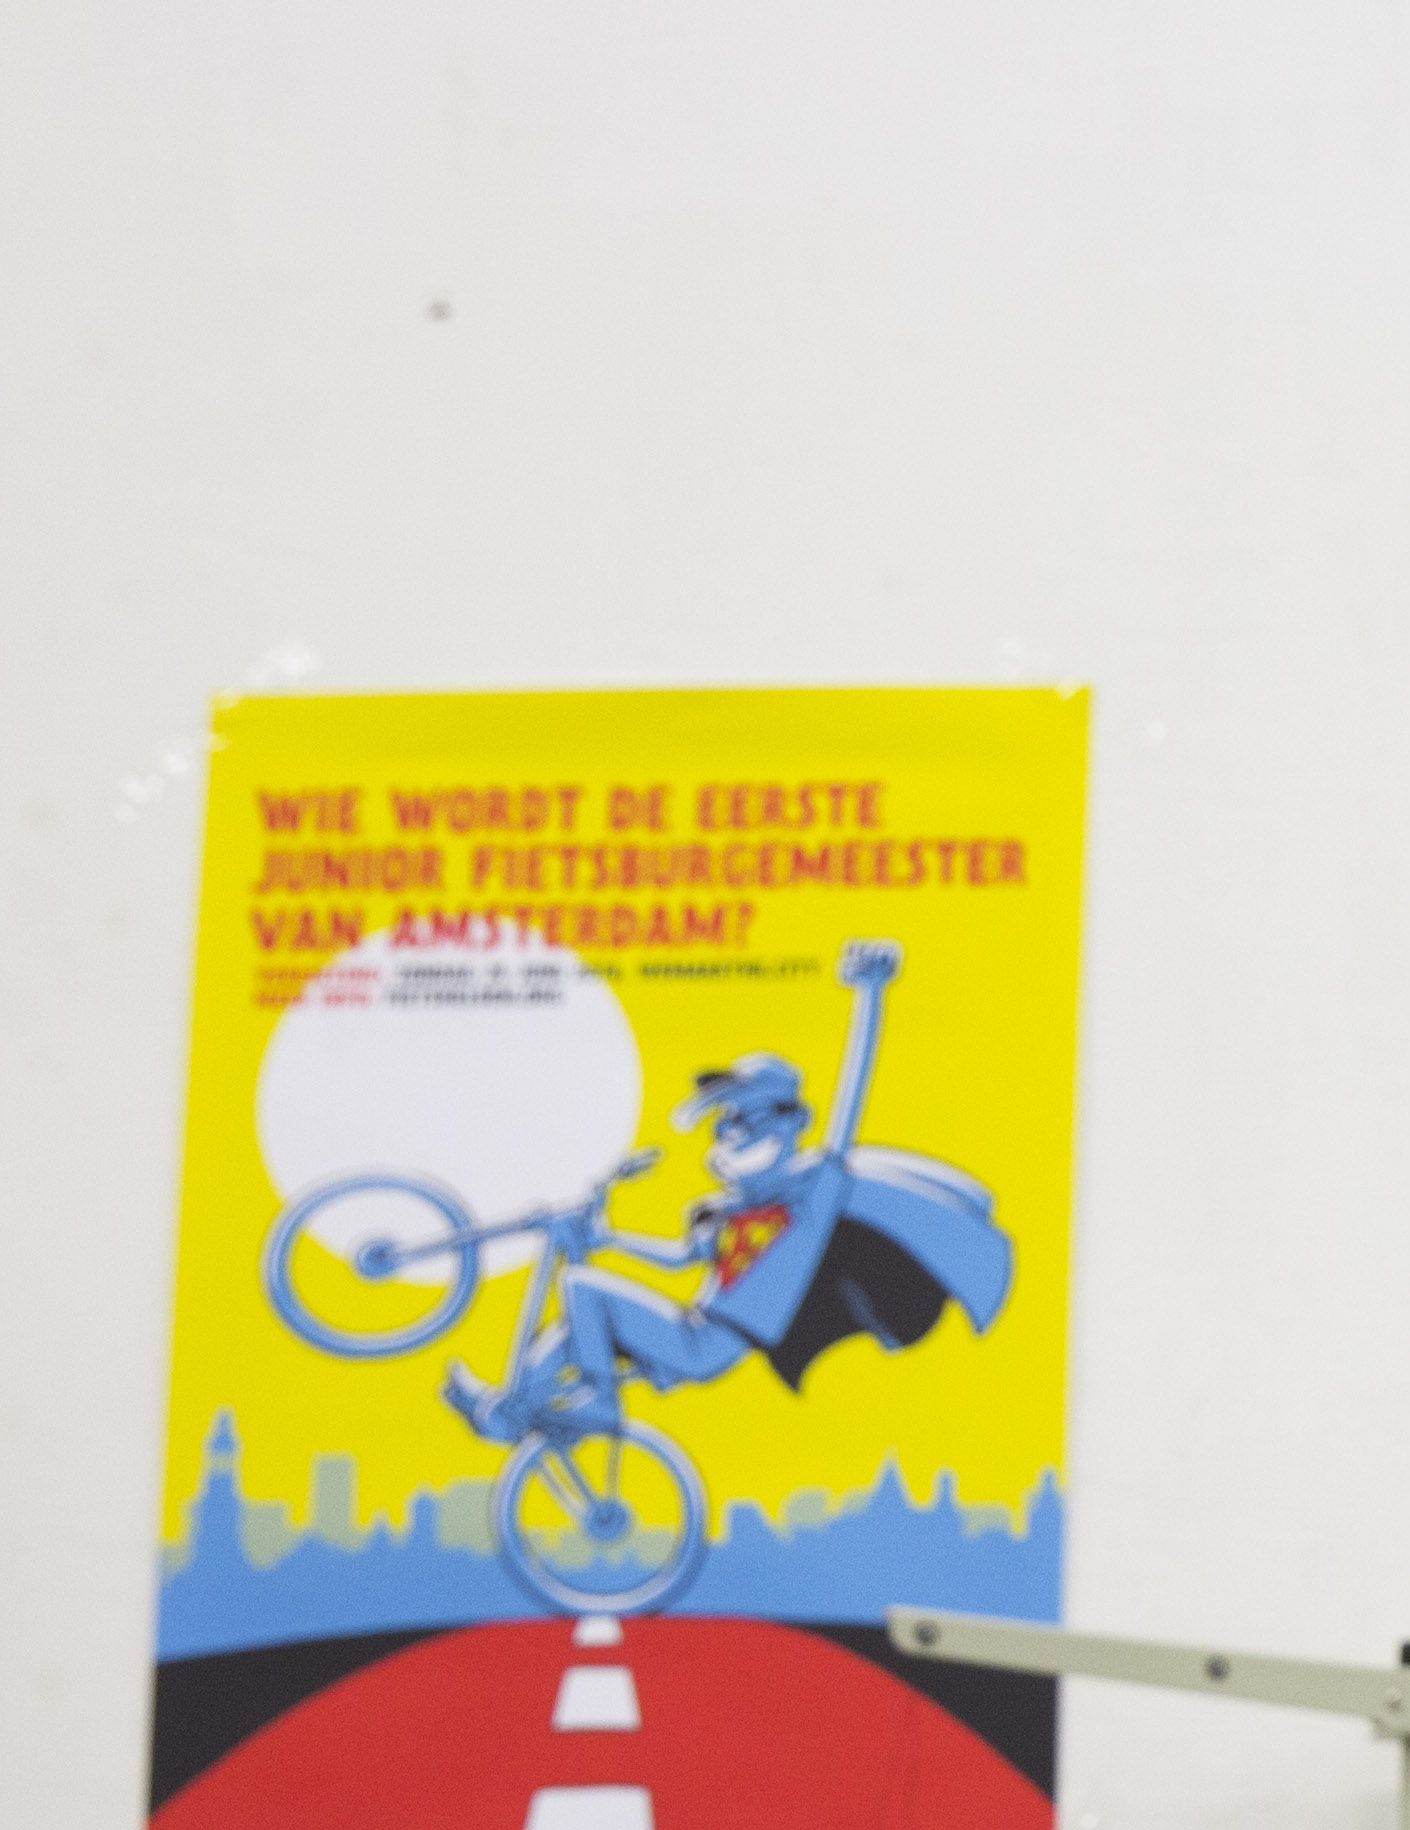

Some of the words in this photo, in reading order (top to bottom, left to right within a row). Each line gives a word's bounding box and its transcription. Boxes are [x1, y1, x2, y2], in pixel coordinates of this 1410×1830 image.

[256, 787, 361, 834] WIE
[390, 786, 583, 832] WORDT
[608, 785, 670, 832] DE
[696, 782, 884, 830] EERSTE
[254, 845, 443, 894] JUNIOR
[470, 839, 1028, 890] FIETSBURGEMEESTER
[250, 906, 363, 952] VAN
[392, 902, 756, 950] AMSTERDAM?
